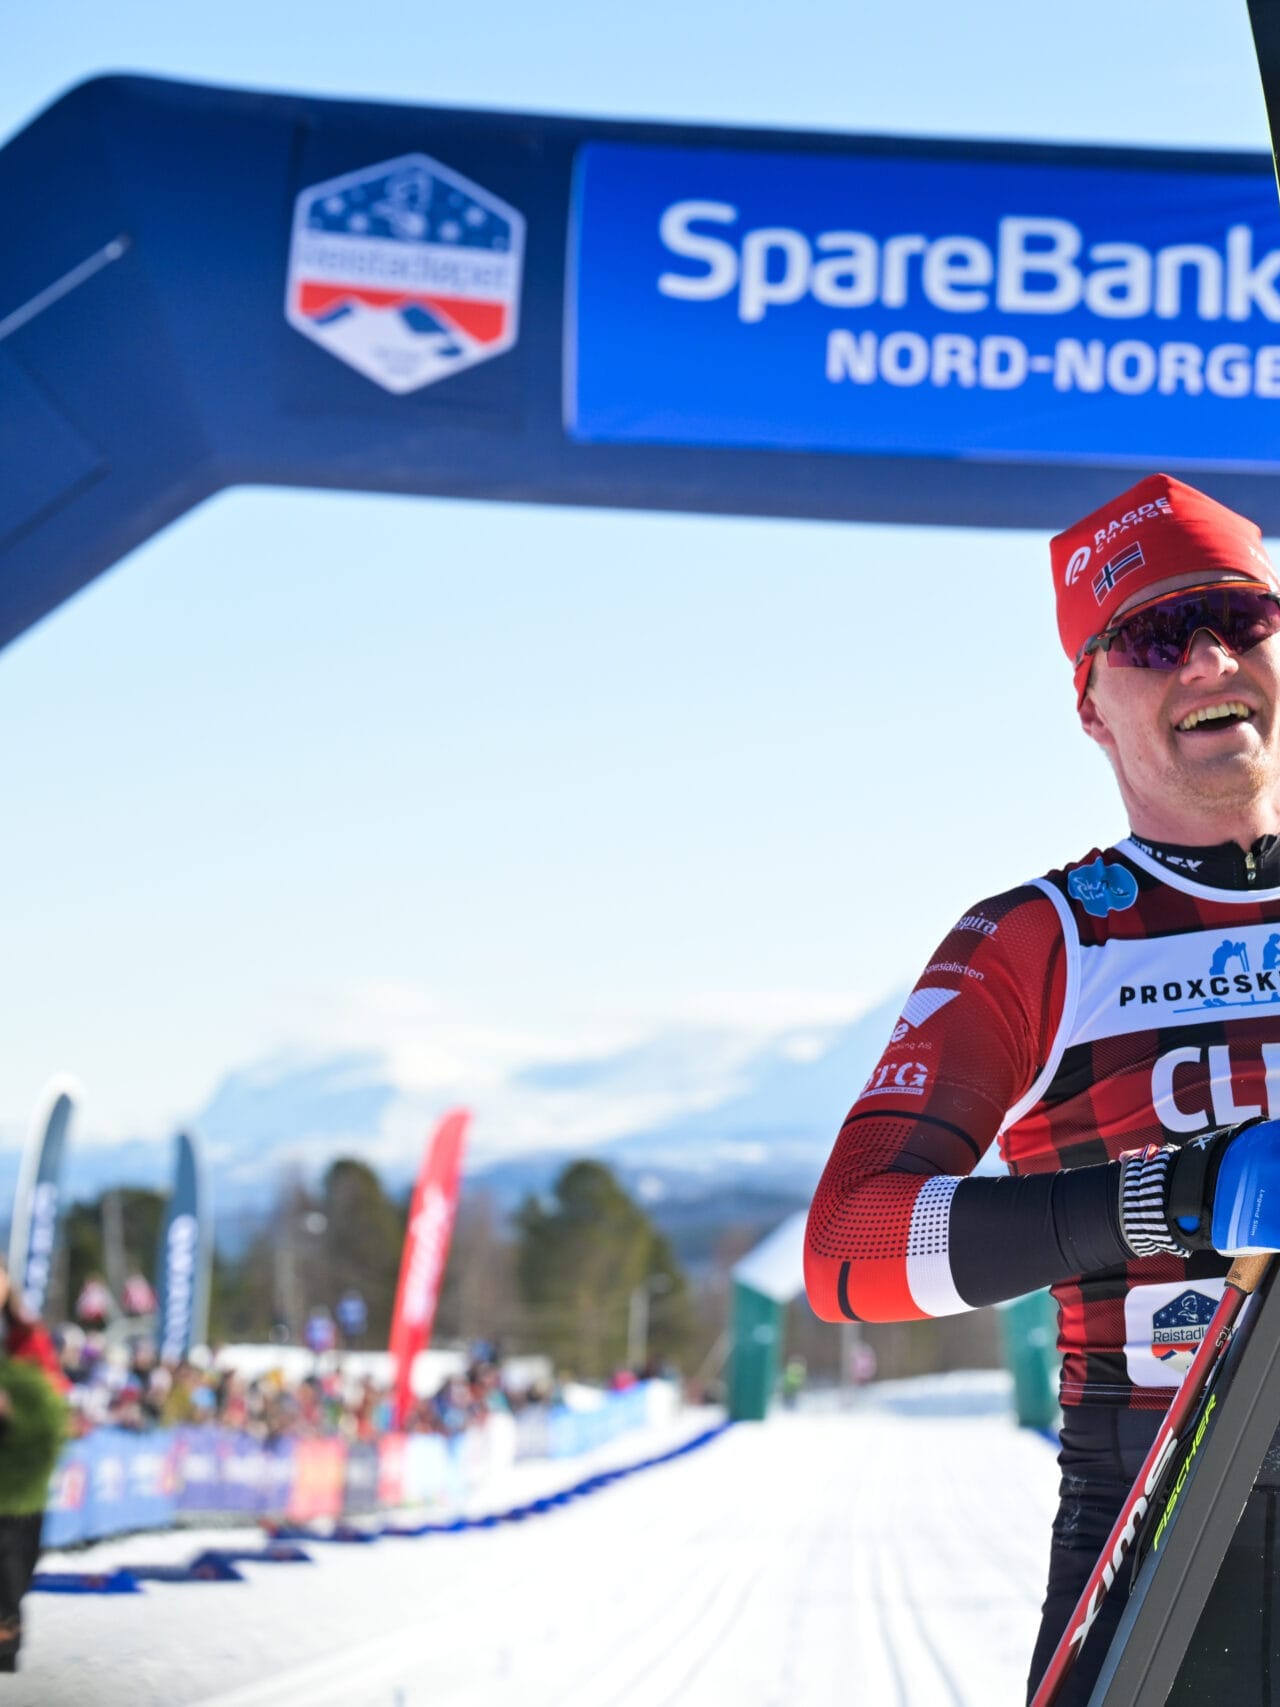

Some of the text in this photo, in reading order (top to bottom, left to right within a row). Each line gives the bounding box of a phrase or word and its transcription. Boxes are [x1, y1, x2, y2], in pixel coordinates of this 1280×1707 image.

[1094, 497, 1171, 546] RAGDE
[1153, 1326, 1207, 1344] Reistadl
[1153, 1394, 1217, 1552] FISCHER
